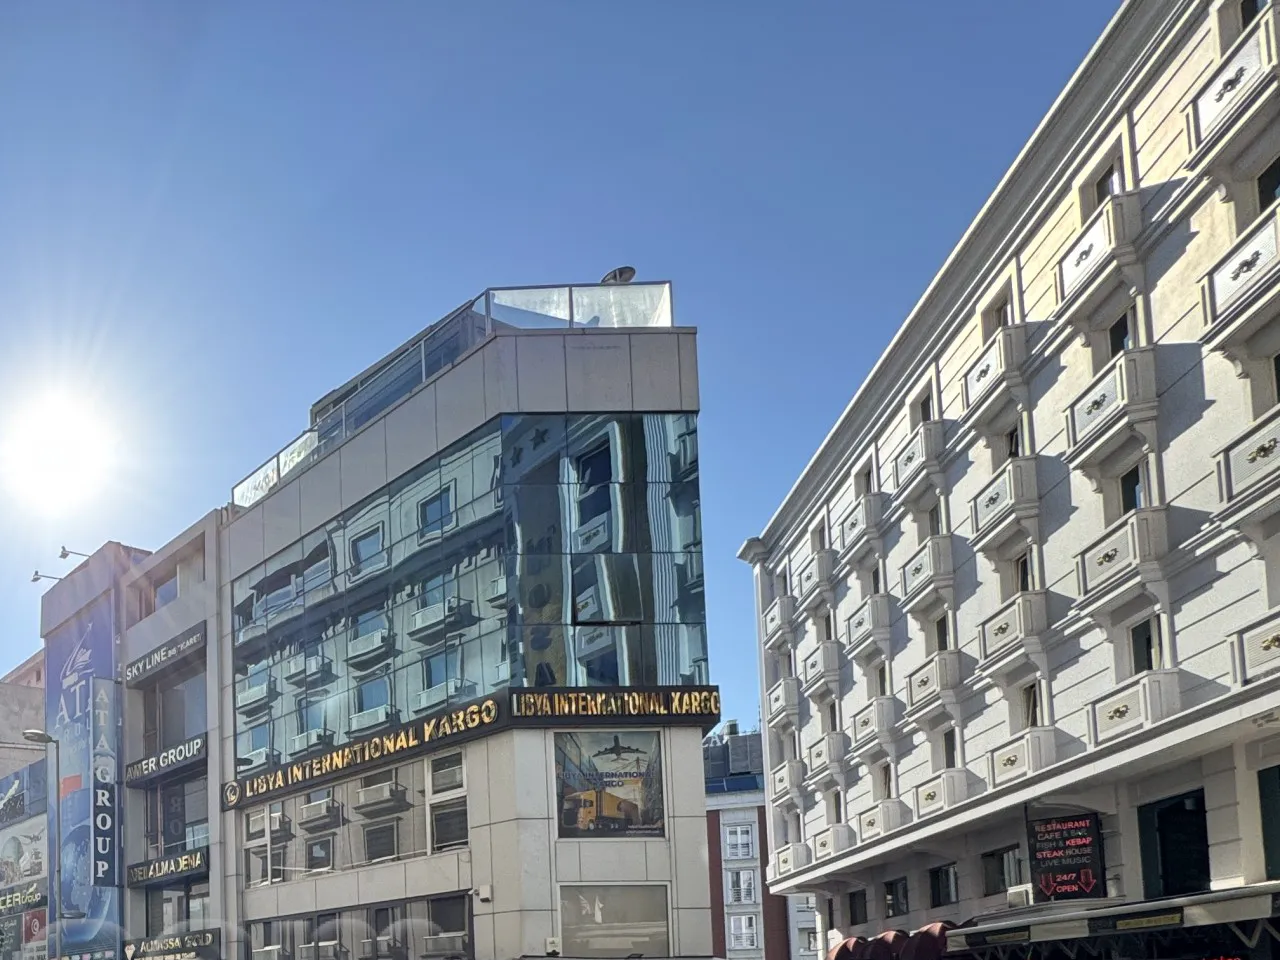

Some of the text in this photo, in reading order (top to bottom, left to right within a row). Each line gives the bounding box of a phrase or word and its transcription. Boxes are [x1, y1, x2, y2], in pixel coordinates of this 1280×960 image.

[126, 661, 144, 680] SKY
[146, 646, 167, 670] LINE
[512, 691, 719, 717] LIBYA INTERNATIONAL KARGO
[159, 738, 202, 768] GROUP
[246, 699, 499, 798] LIBYA INTERNATIONAL KARGO
[1035, 820, 1091, 832] RESTAURANT
[1037, 831, 1061, 840] CAFE
[1065, 837, 1092, 847] KEBAP
[1036, 847, 1092, 859] STEAK HOUSE
[1055, 873, 1076, 881] 24/7
[1056, 884, 1079, 893] OPEN
